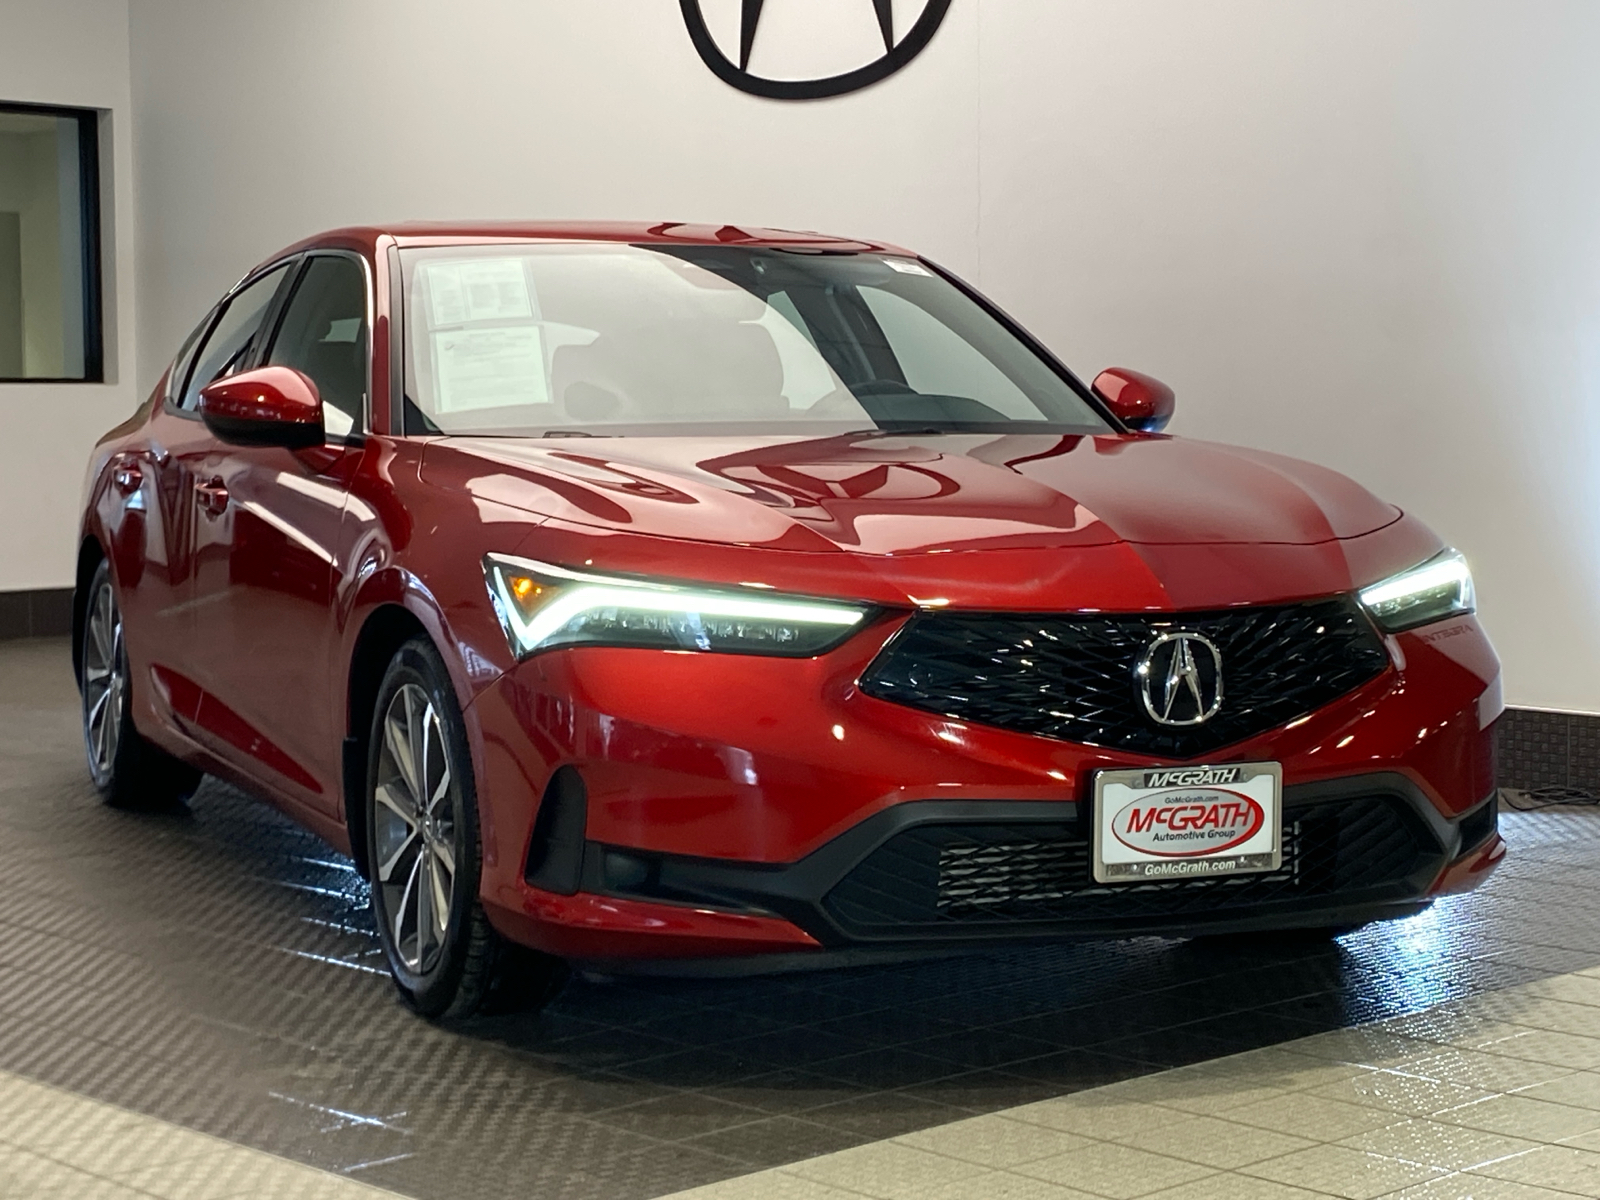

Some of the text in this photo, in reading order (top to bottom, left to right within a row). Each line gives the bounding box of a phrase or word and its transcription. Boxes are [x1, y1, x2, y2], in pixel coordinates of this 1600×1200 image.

[1164, 795, 1219, 804] GoMcGrath.com
[1152, 829, 1236, 842] Automotive Group
[1144, 859, 1236, 876] GoMcGrath.com
